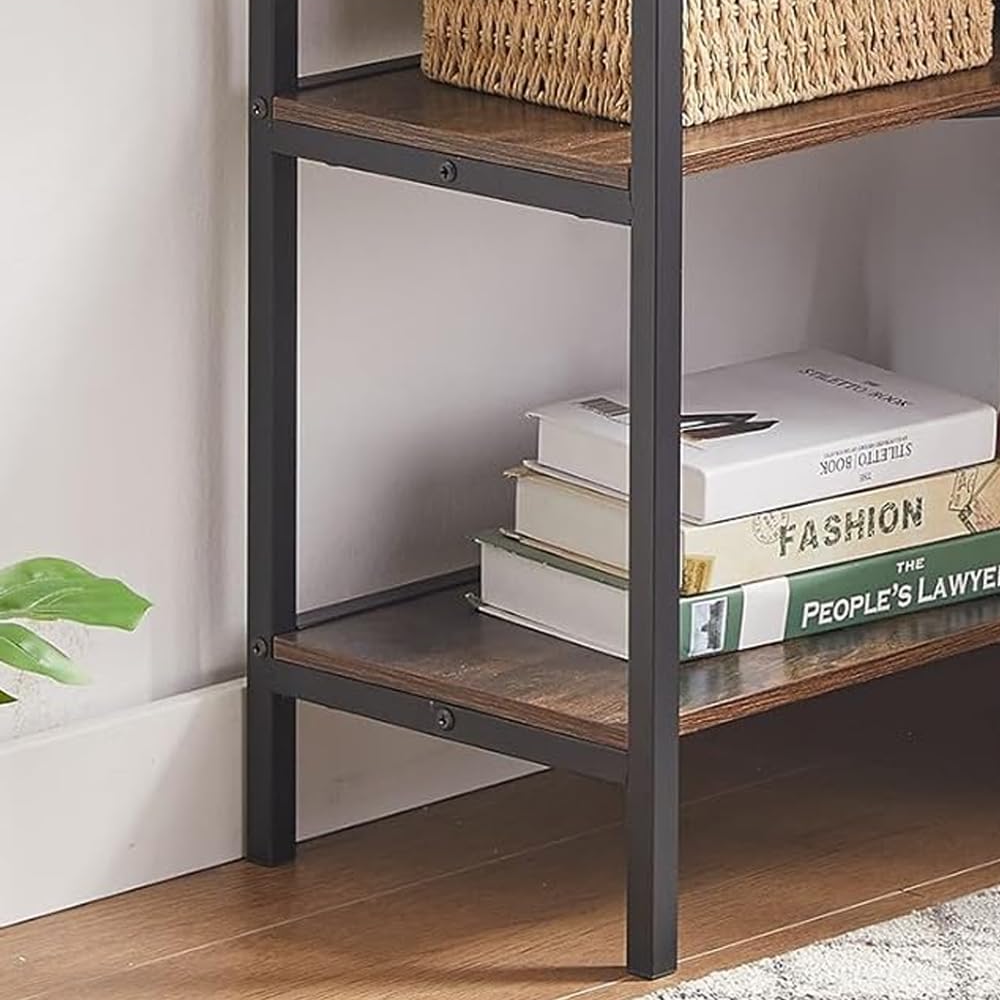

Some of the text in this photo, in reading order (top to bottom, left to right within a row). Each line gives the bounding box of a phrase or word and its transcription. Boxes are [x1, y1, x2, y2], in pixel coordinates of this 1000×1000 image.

[819, 455, 853, 475] BOOK
[857, 442, 913, 467] STILETTO
[776, 496, 924, 556] FASHION
[896, 557, 925, 574] THE
[801, 582, 912, 629] PEOPLE'S
